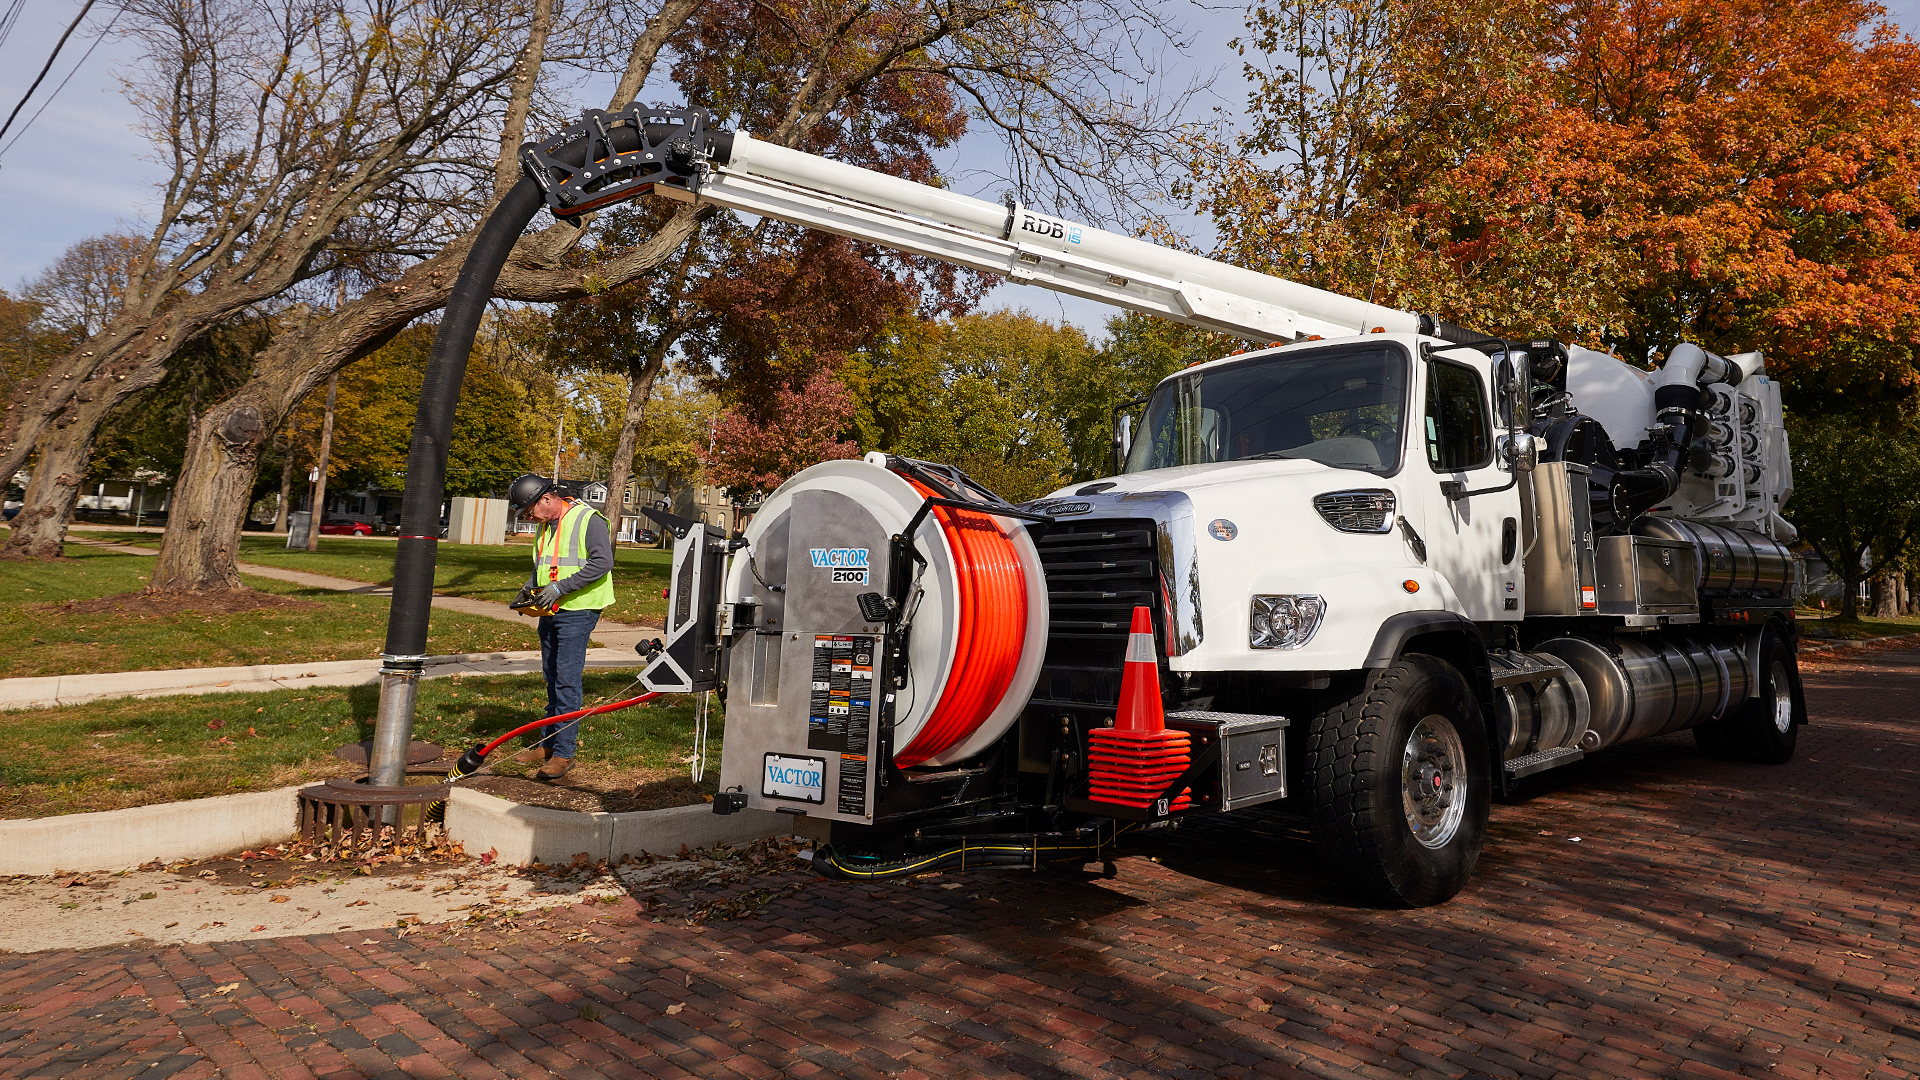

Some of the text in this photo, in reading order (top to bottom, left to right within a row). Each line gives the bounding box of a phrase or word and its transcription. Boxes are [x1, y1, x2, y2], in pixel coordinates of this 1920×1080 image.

[1022, 214, 1063, 238] RDB
[1068, 234, 1081, 244] 15
[811, 549, 868, 566] VACTOR
[833, 571, 868, 584] 2100i
[768, 765, 821, 788] VACTOR
